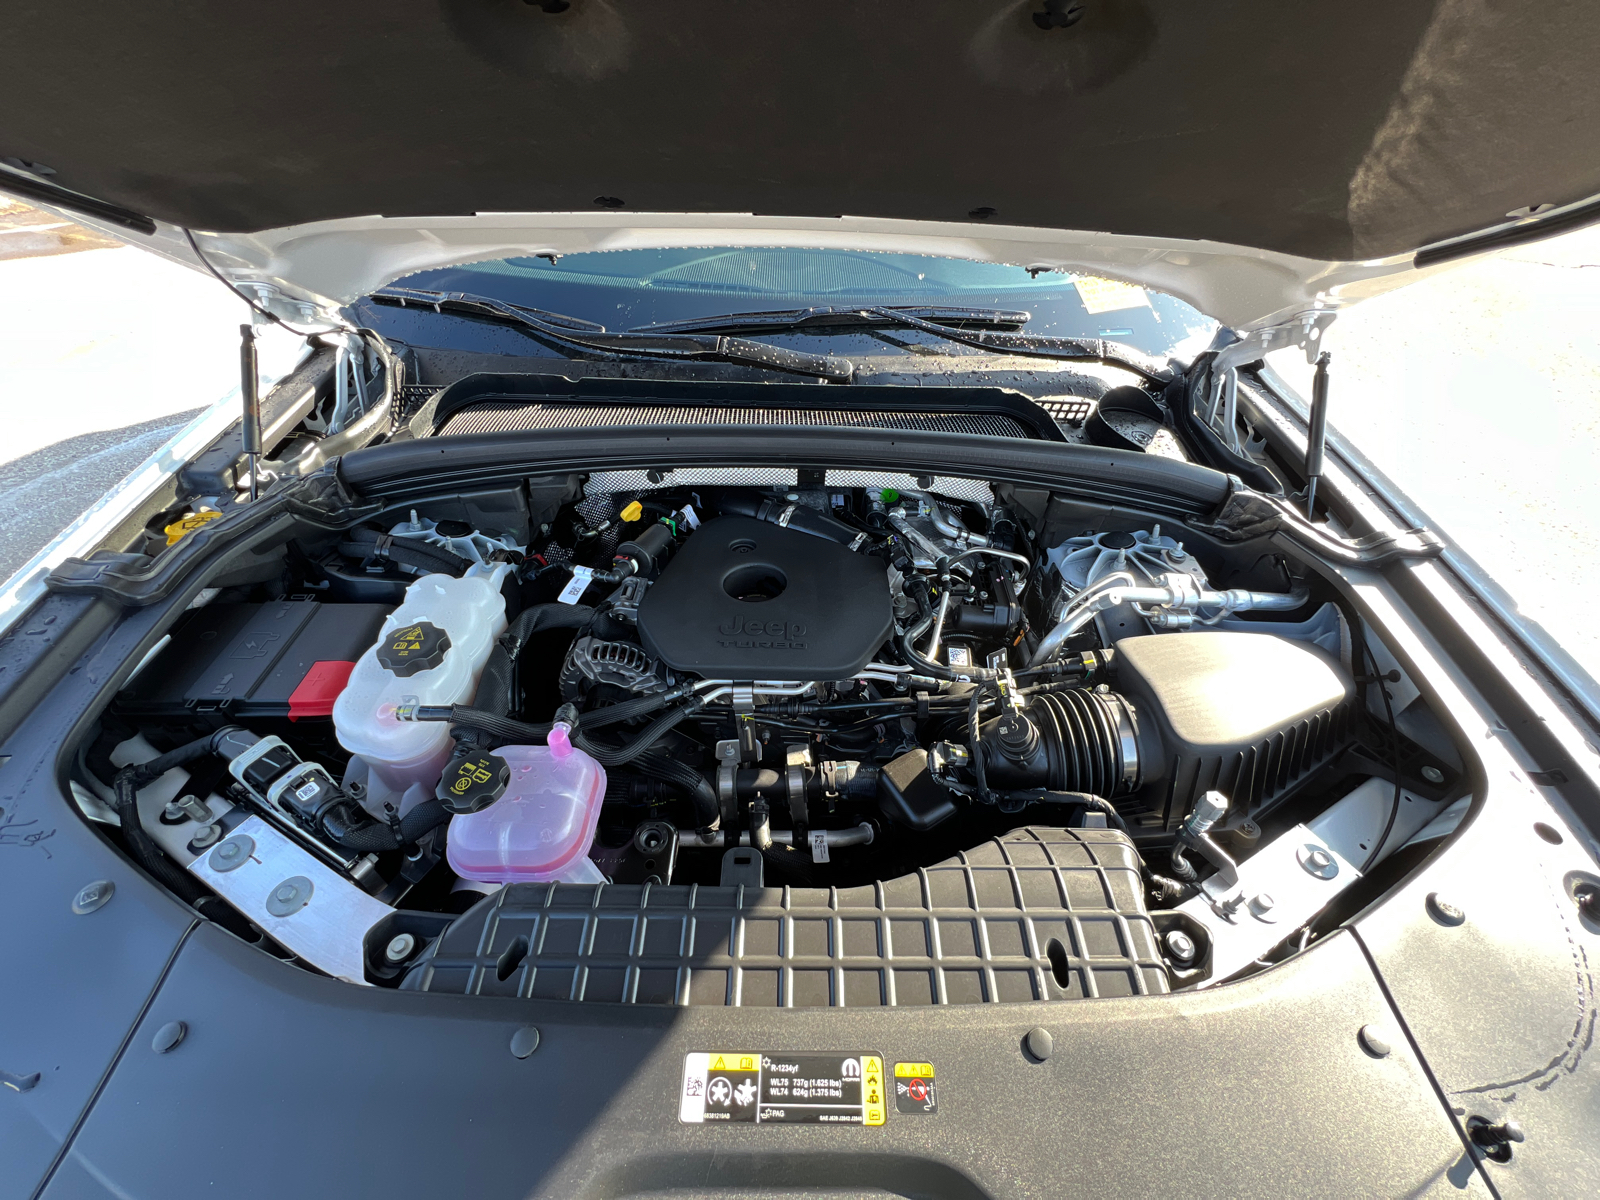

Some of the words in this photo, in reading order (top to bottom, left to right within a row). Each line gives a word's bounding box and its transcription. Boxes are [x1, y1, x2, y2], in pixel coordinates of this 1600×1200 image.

[719, 615, 807, 641] Jeep
[717, 641, 808, 650] TURBO
[770, 1064, 799, 1074] R-1234yf
[770, 1078, 789, 1086] WL75
[793, 1079, 808, 1088] 737g
[809, 1079, 828, 1088] (1.625
[829, 1079, 842, 1089] lbs)
[770, 1088, 789, 1096] WL74
[792, 1088, 808, 1098] 624g
[809, 1088, 828, 1098] (1.375
[829, 1089, 842, 1099] lbs)
